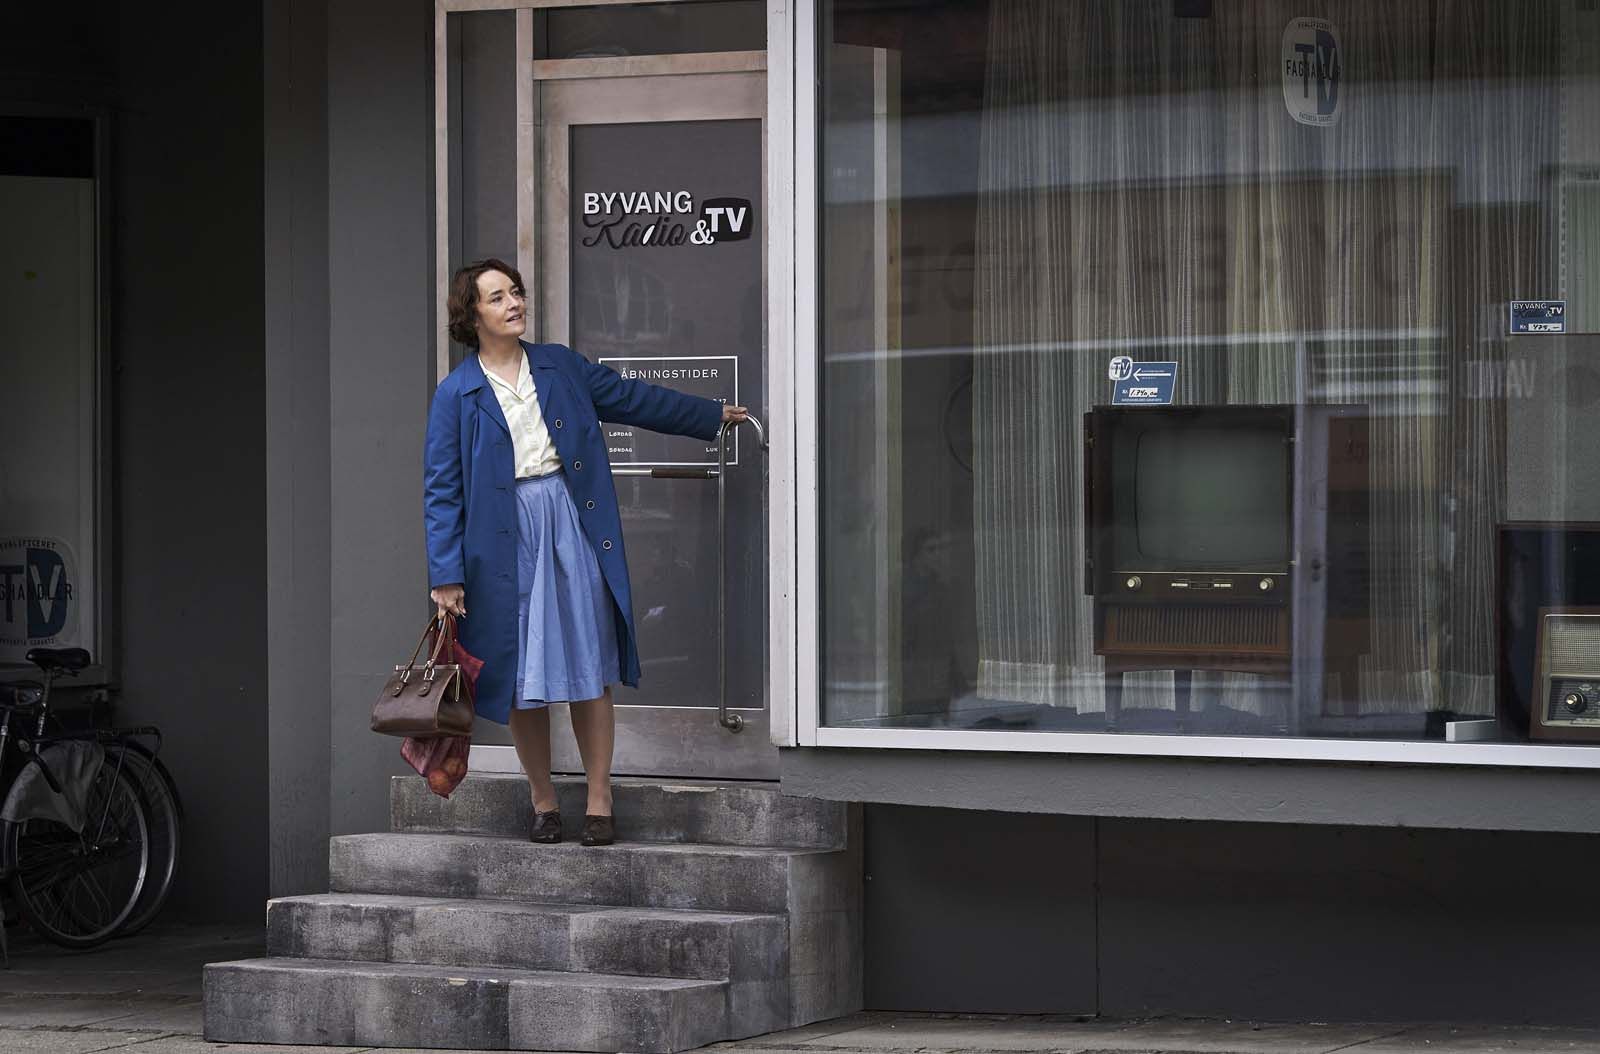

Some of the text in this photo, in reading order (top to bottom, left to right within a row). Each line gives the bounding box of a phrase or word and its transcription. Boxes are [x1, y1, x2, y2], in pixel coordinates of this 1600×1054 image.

[1286, 59, 1342, 83] FAGHANDLR
[1294, 43, 1337, 101] TV
[584, 190, 694, 216] BYVANG
[583, 199, 747, 250] Radio & TV
[1513, 302, 1547, 310] BYVANG
[1550, 306, 1562, 315] TV
[620, 368, 719, 379] ÅBNINGSTIDER
[1113, 362, 1130, 376] TV
